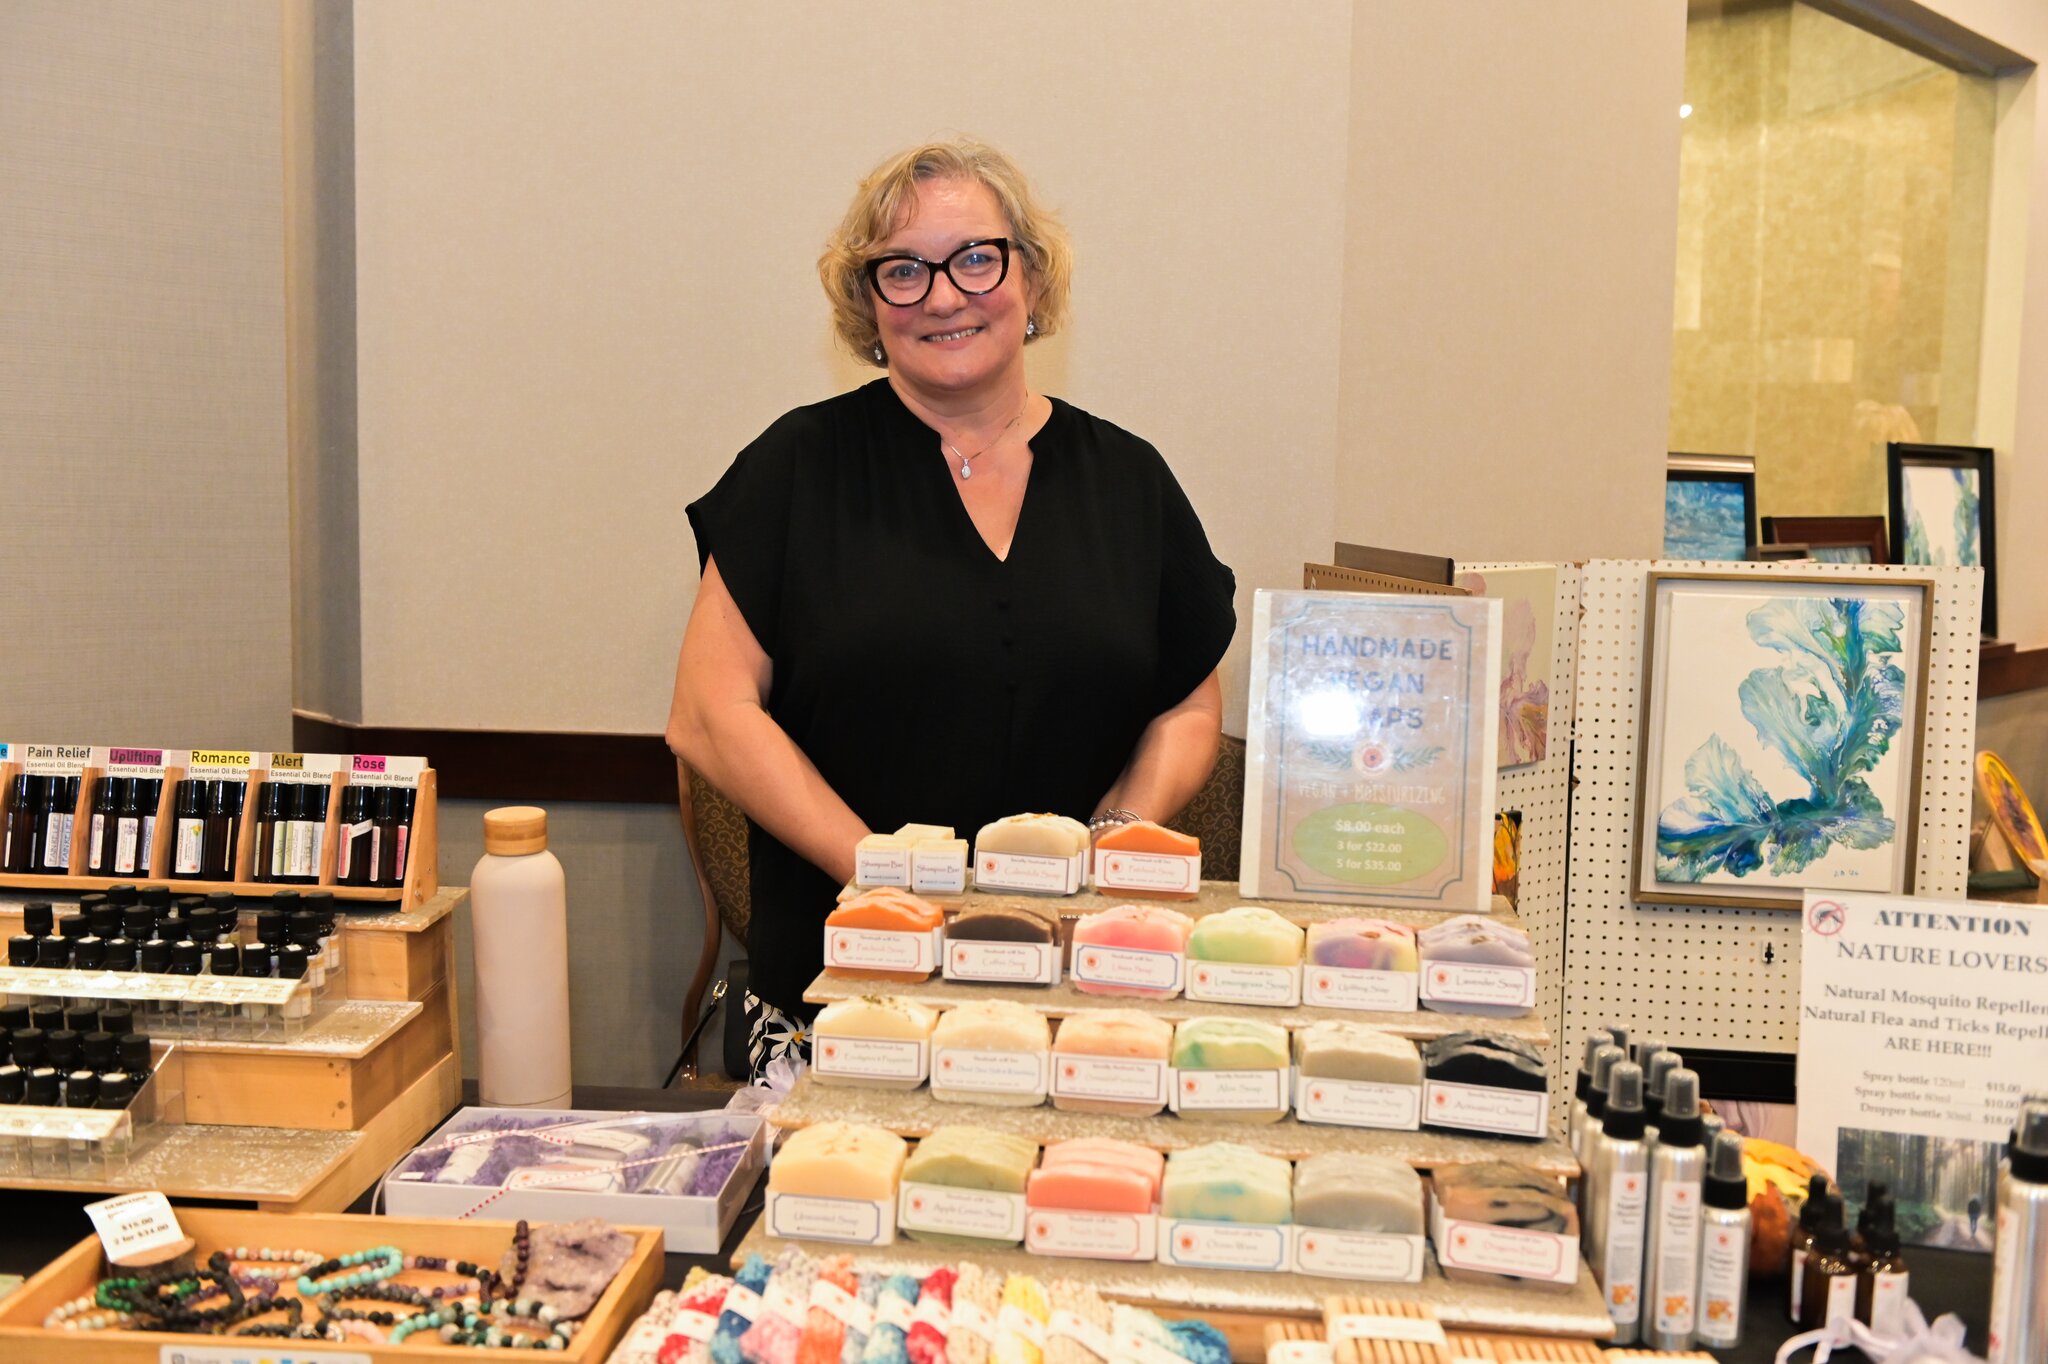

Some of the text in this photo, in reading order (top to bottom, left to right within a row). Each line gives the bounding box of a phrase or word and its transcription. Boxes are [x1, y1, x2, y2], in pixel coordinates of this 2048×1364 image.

[1302, 634, 1453, 660] HANDMADE
[27, 746, 91, 759] Pain Relief
[109, 749, 162, 765] Uplifting
[191, 750, 251, 764] Romance
[26, 760, 56, 768] Essential
[56, 761, 66, 769] Oil
[271, 753, 304, 768] Alert
[353, 756, 386, 770] Rose
[108, 765, 138, 774] Essential
[139, 766, 148, 774] Oil
[190, 766, 220, 775] Essential
[221, 767, 230, 775] Oil
[270, 769, 332, 780] Essential Oil Blend
[351, 772, 382, 781] Essential
[393, 774, 414, 783] Blend
[1335, 818, 1405, 834] $8.00 each
[1336, 840, 1402, 853] 3 for $22.00
[1346, 858, 1362, 869] for
[1364, 859, 1402, 871] $35.00
[1875, 910, 2031, 936] ATTENTION
[1837, 941, 2048, 974] NATURE LOVERS
[1496, 978, 1523, 992] Soap
[1825, 984, 1886, 1002] Natural
[1891, 989, 1971, 1010] Mosquito
[1804, 1005, 1865, 1023] Natural
[1871, 1011, 1904, 1027] Flea
[1909, 1016, 1939, 1030] and
[1944, 1017, 1990, 1034] Ticks
[1884, 1036, 1992, 1058] ARE HERE!!!
[1863, 1070, 1894, 1083] Spray
[1897, 1073, 1930, 1086] bottle
[1855, 1085, 1887, 1100] Spray
[1890, 1089, 1921, 1102] bottle
[1860, 1102, 1907, 1118] Dropper
[1909, 1106, 1942, 1120] bottle
